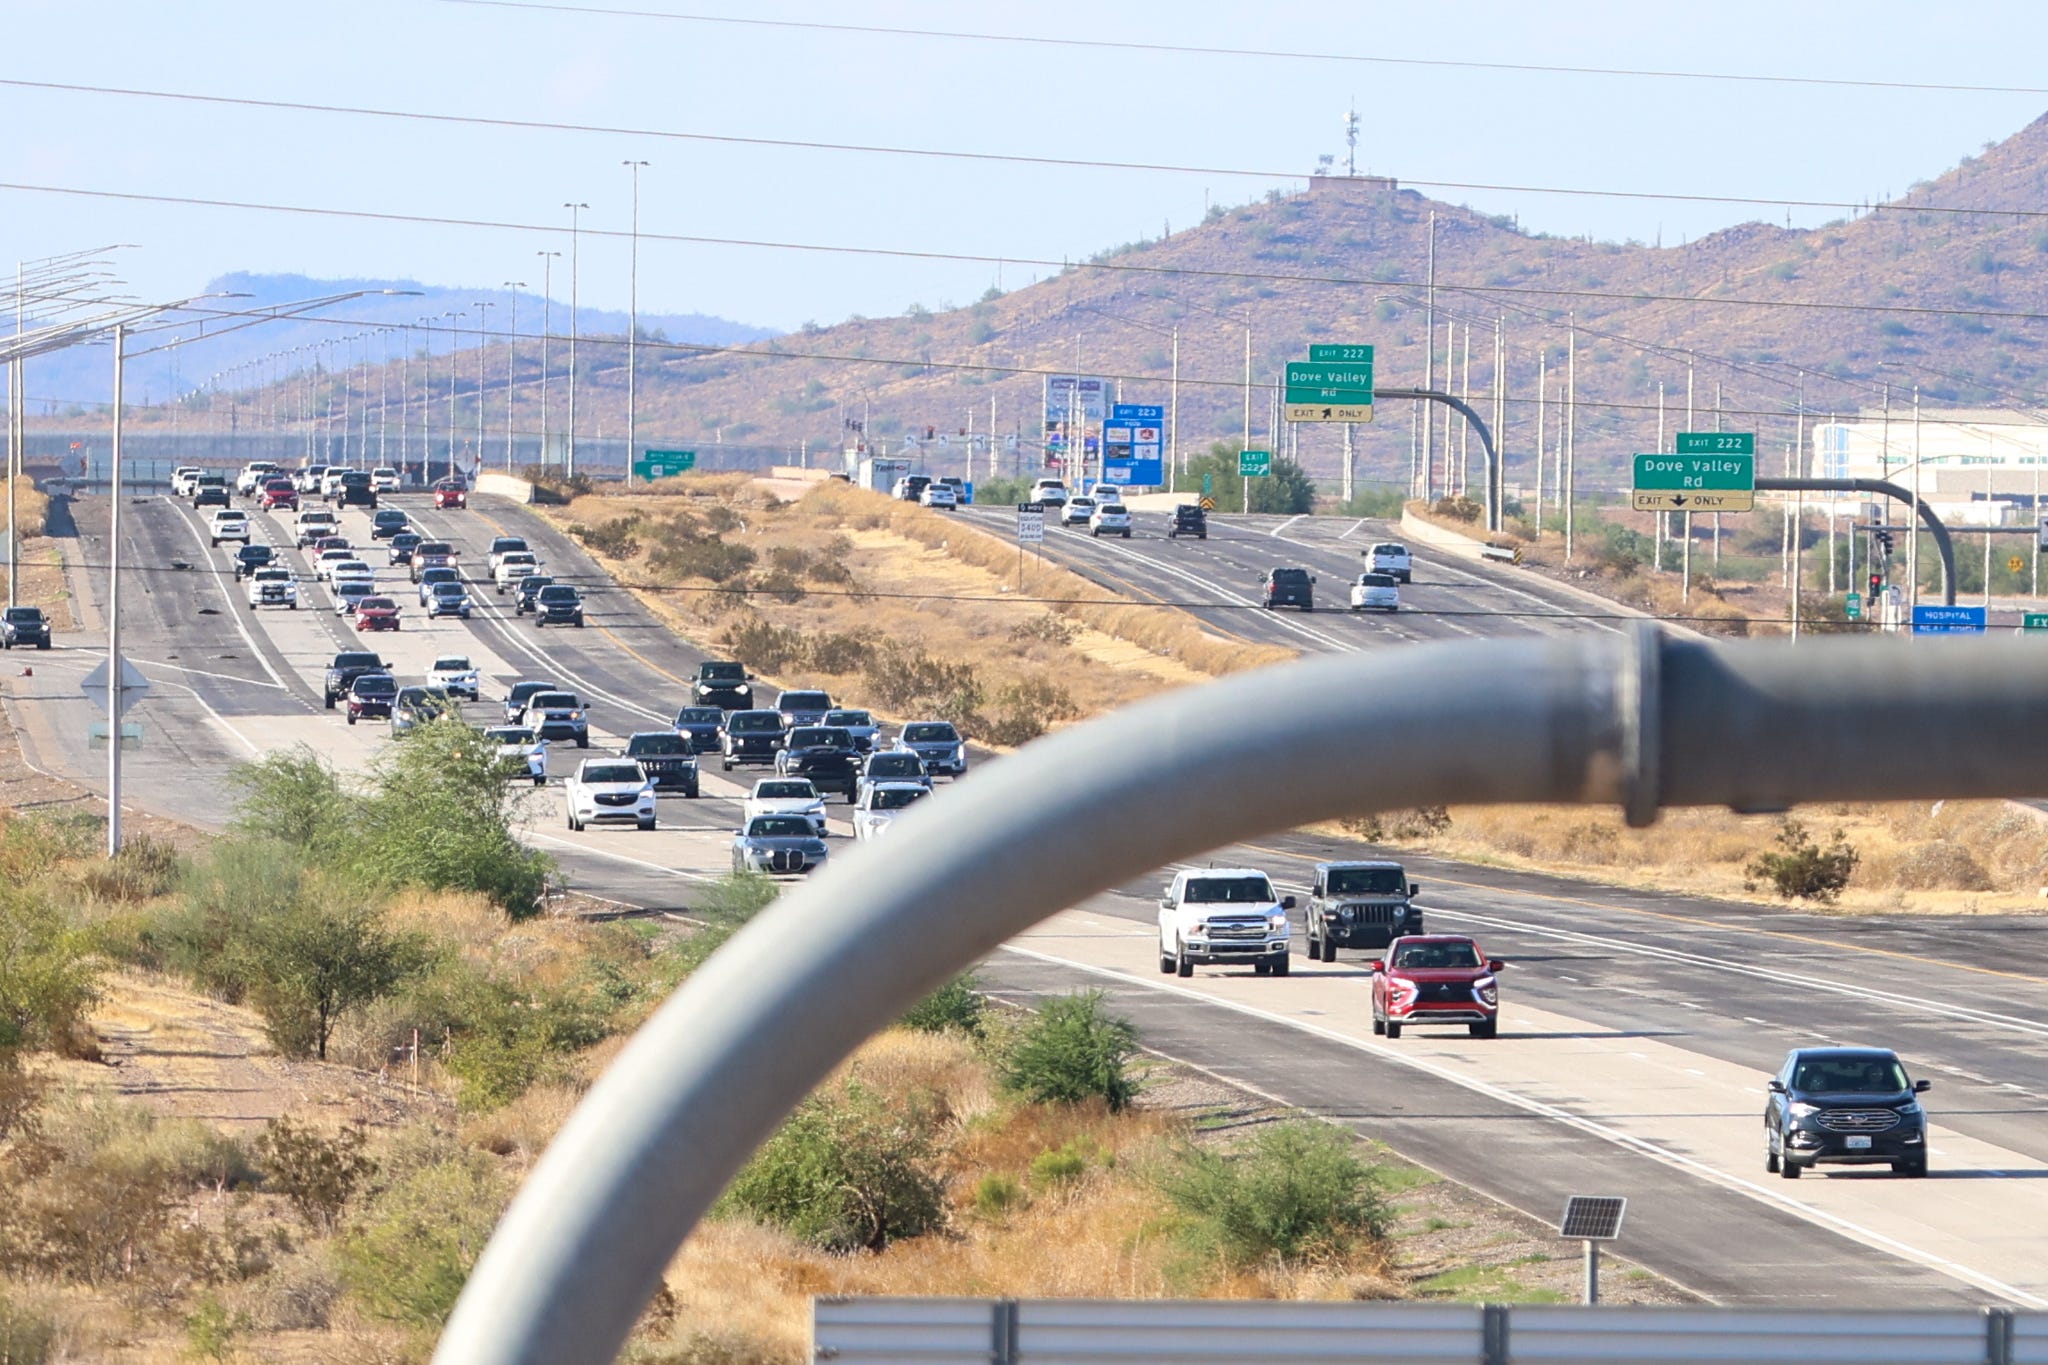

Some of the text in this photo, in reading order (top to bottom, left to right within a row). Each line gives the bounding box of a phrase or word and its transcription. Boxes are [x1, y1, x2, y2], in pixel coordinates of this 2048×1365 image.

[1319, 349, 1365, 358] EXIT 222
[1291, 372, 1367, 385] Dove Valley
[1320, 387, 1337, 397] Rd
[1293, 409, 1363, 417] EXIT ONLY
[1688, 438, 1742, 448] EXIT 222
[1245, 453, 1264, 461] EXIT
[1240, 463, 1259, 471] 222
[1645, 460, 1742, 474] Dove Valley
[1683, 476, 1703, 487] Rd
[1638, 496, 1725, 505] EXIT ONLY
[1924, 611, 1972, 620] HOSPITAL
